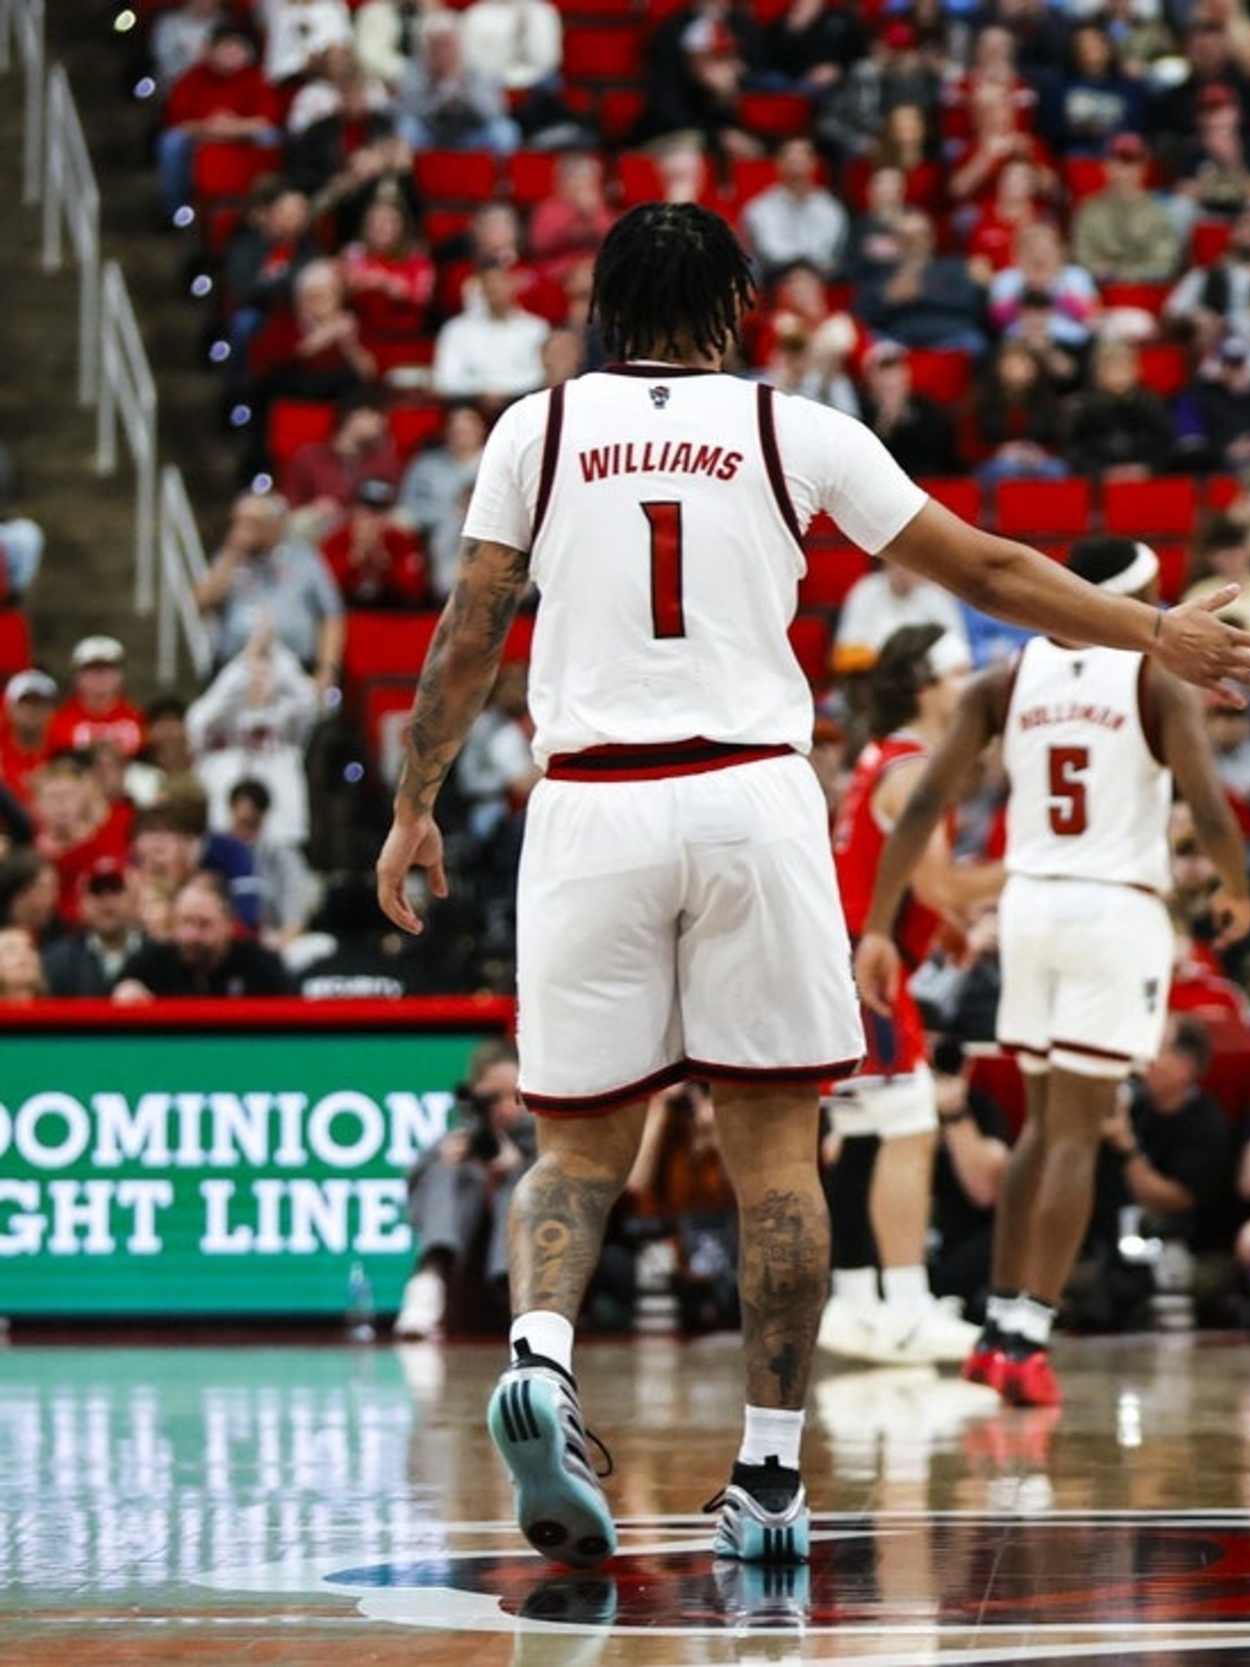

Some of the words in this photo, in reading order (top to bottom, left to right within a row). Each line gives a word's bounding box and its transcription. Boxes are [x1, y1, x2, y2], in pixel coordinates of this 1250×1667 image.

[579, 441, 743, 483] WILLIAMS
[638, 500, 686, 640] 1
[1048, 745, 1089, 836] 5
[0, 1091, 453, 1169] OMINION
[200, 1179, 413, 1255] LINE
